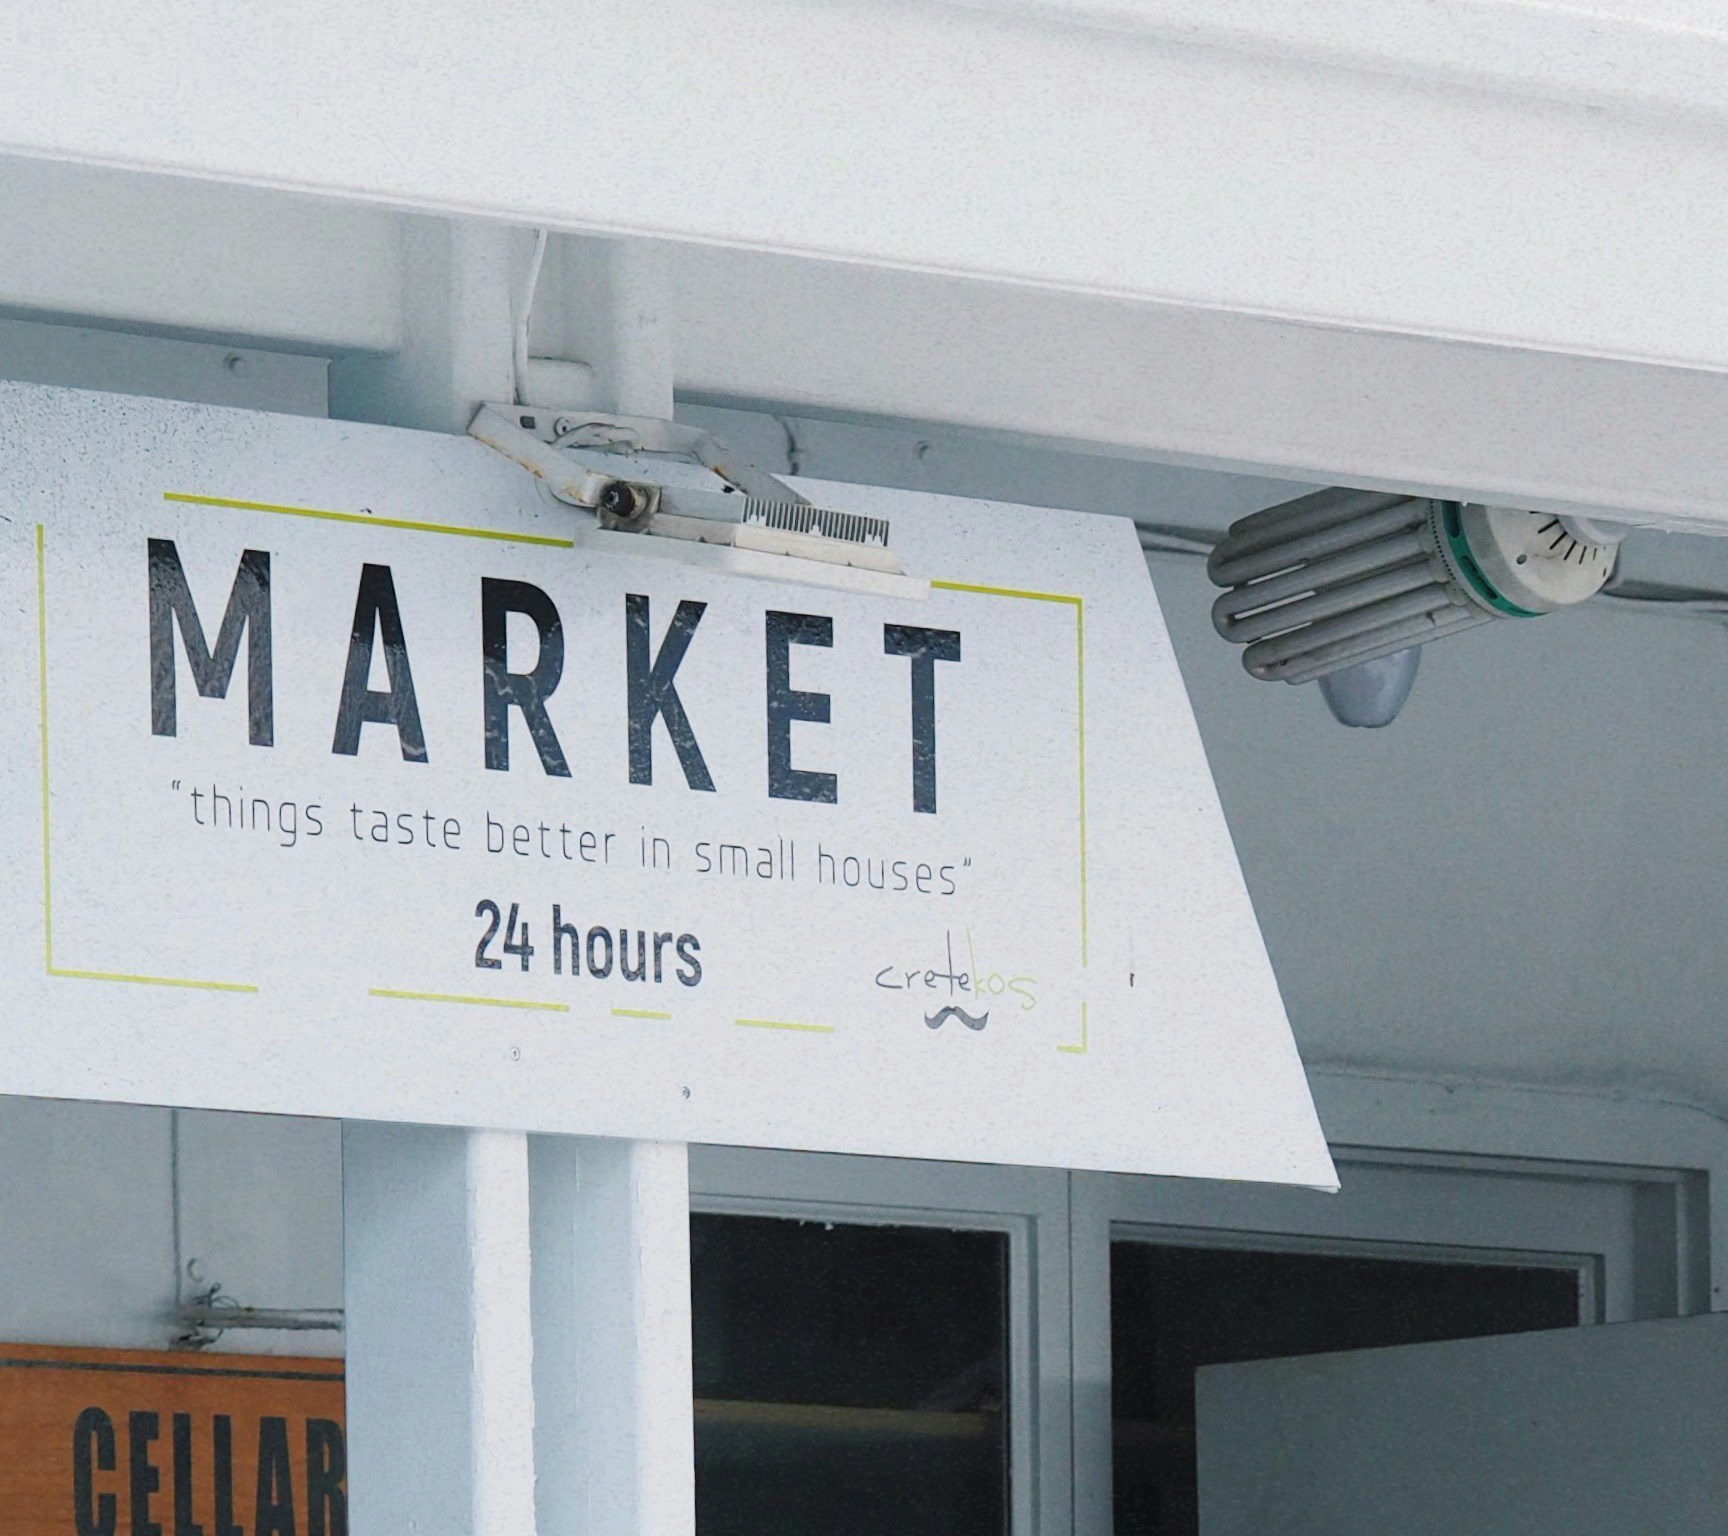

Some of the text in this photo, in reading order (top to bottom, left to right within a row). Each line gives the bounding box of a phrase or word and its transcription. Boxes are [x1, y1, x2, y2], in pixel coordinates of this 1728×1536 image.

[147, 537, 961, 814] MARKET
[348, 799, 461, 849] taste
[487, 809, 615, 865] better
[641, 826, 670, 870] in
[696, 834, 795, 882] small
[475, 899, 703, 988] 24 hours
